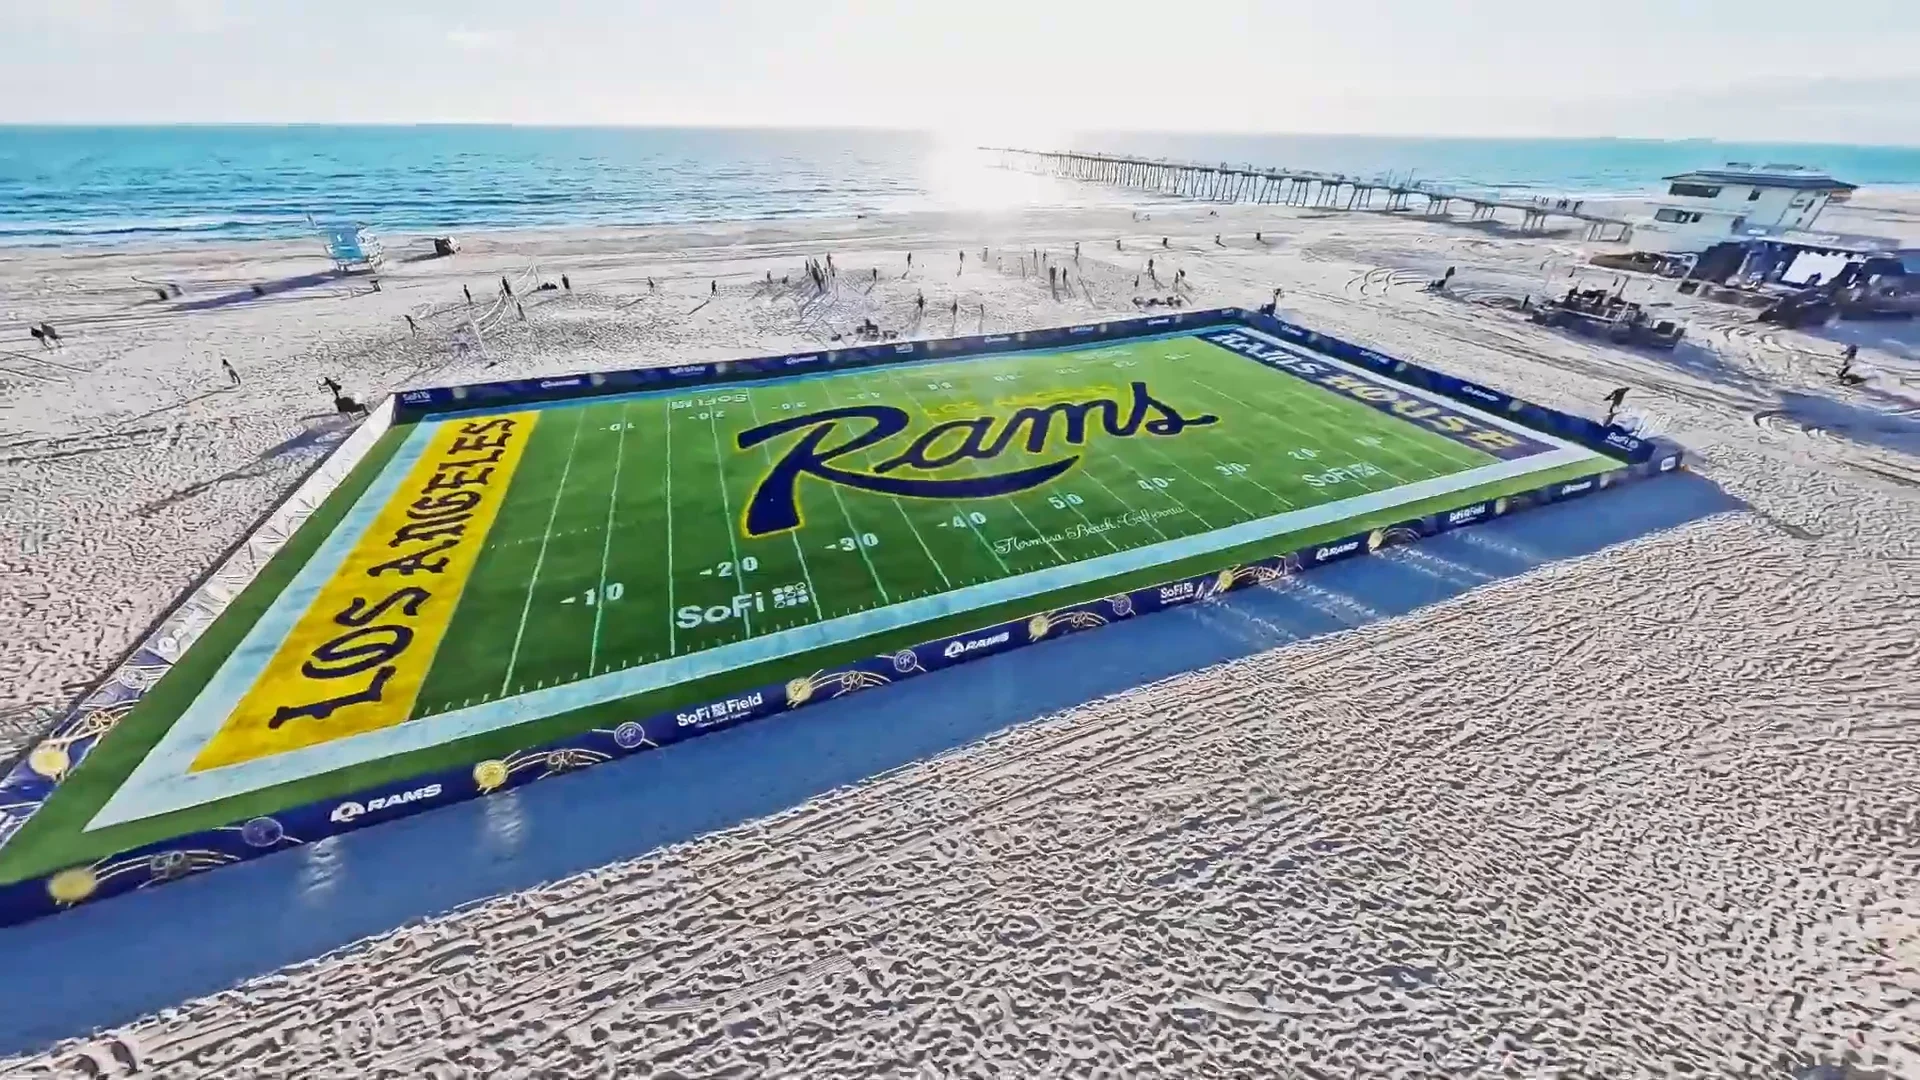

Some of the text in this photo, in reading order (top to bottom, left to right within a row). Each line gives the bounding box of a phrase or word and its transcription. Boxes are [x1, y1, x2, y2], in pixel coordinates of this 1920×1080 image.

[736, 380, 1221, 538] Rams
[1301, 466, 1354, 488] SoFi
[1047, 493, 1084, 510] 50
[952, 511, 988, 529] 40
[839, 532, 879, 552] 30
[268, 417, 518, 730] LOS ANGELES
[717, 555, 759, 578] 20
[583, 581, 625, 607] 10
[675, 590, 766, 629] SoFi
[965, 631, 1010, 652] RAMS
[676, 705, 711, 727] SoFi
[725, 691, 764, 713] Field
[367, 783, 442, 812] RAMS
